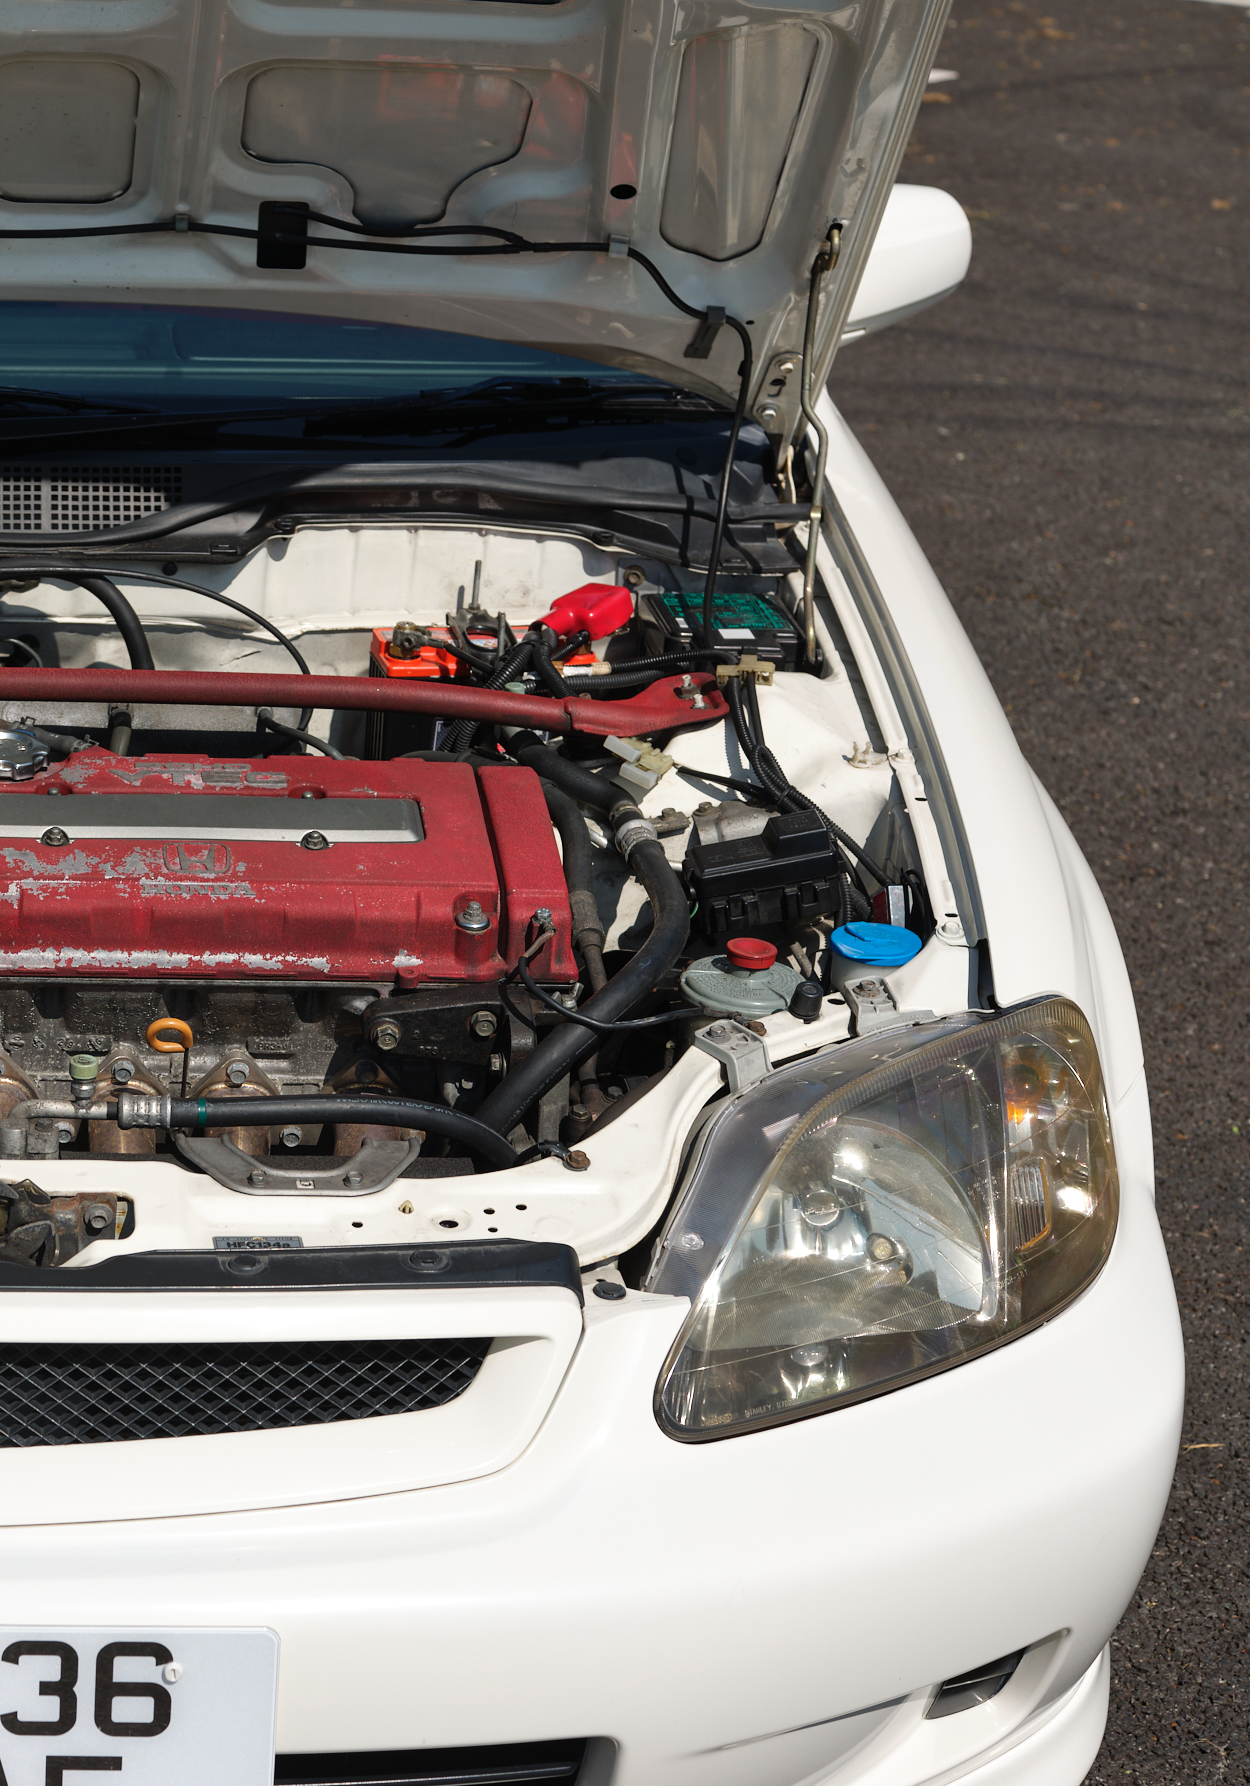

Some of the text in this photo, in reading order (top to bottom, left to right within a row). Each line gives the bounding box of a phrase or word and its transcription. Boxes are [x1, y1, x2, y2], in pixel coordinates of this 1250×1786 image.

[108, 769, 288, 786] VTEC
[141, 883, 256, 896] HONDA
[226, 1241, 291, 1249] HFC134a
[744, 1404, 771, 1419] STANLEY
